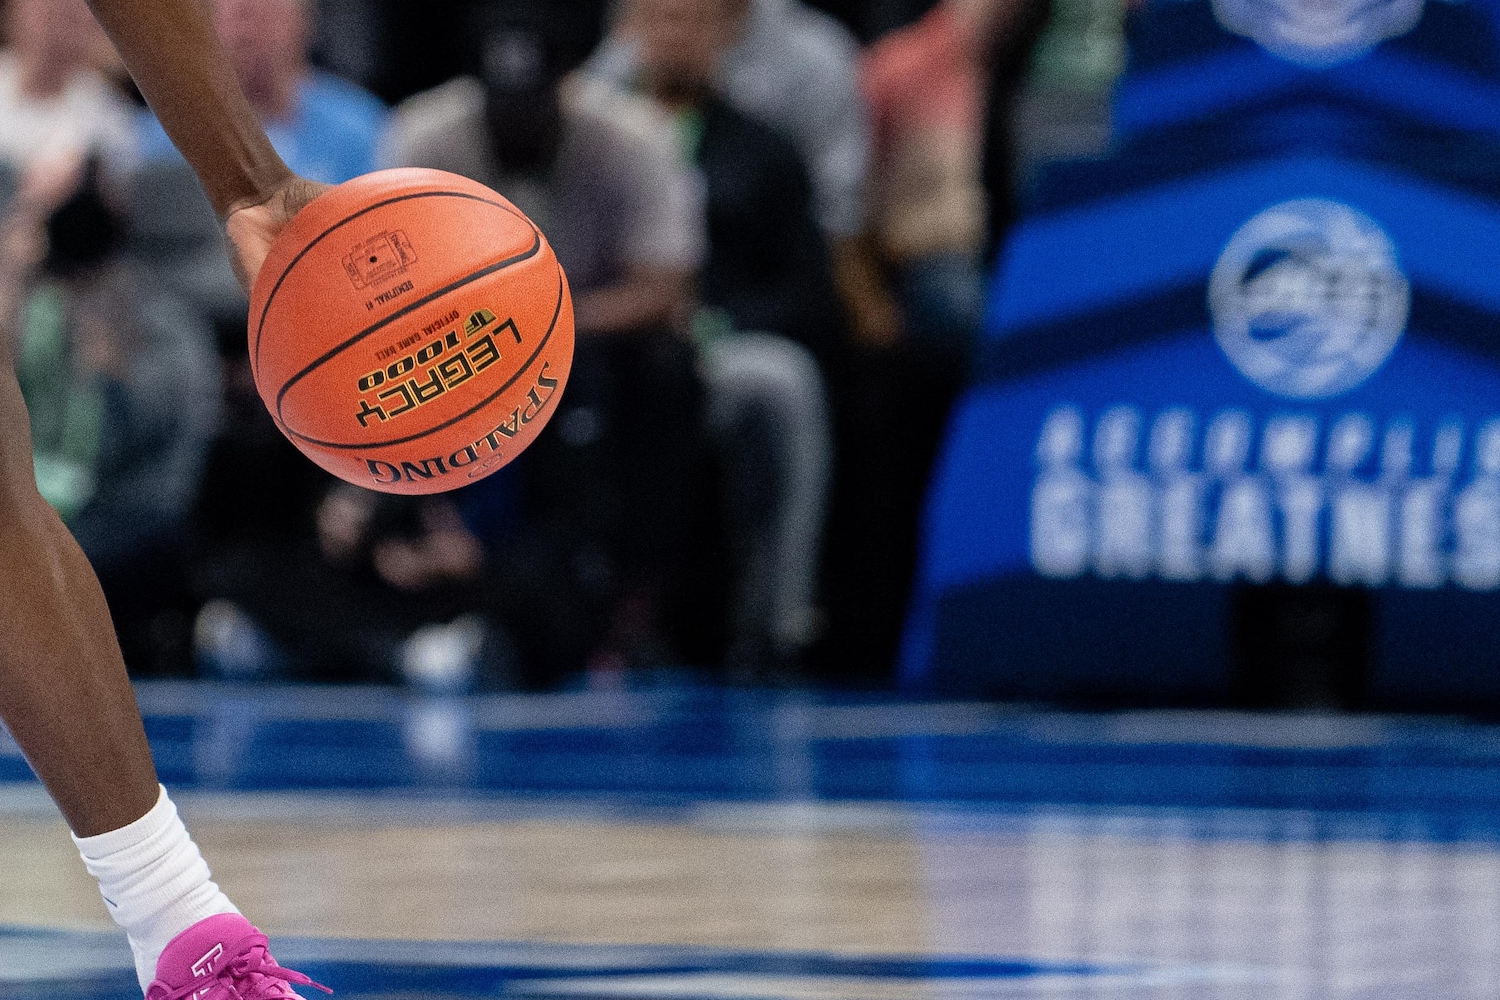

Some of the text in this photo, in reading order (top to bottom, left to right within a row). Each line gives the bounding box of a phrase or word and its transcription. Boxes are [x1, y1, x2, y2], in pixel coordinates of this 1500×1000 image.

[374, 280, 414, 305] SEMIFINAL
[357, 330, 461, 393] 1000
[374, 310, 460, 362] OFFICIAL GAME BALL
[355, 316, 523, 427] LEGACY
[365, 360, 559, 484] SPALDING
